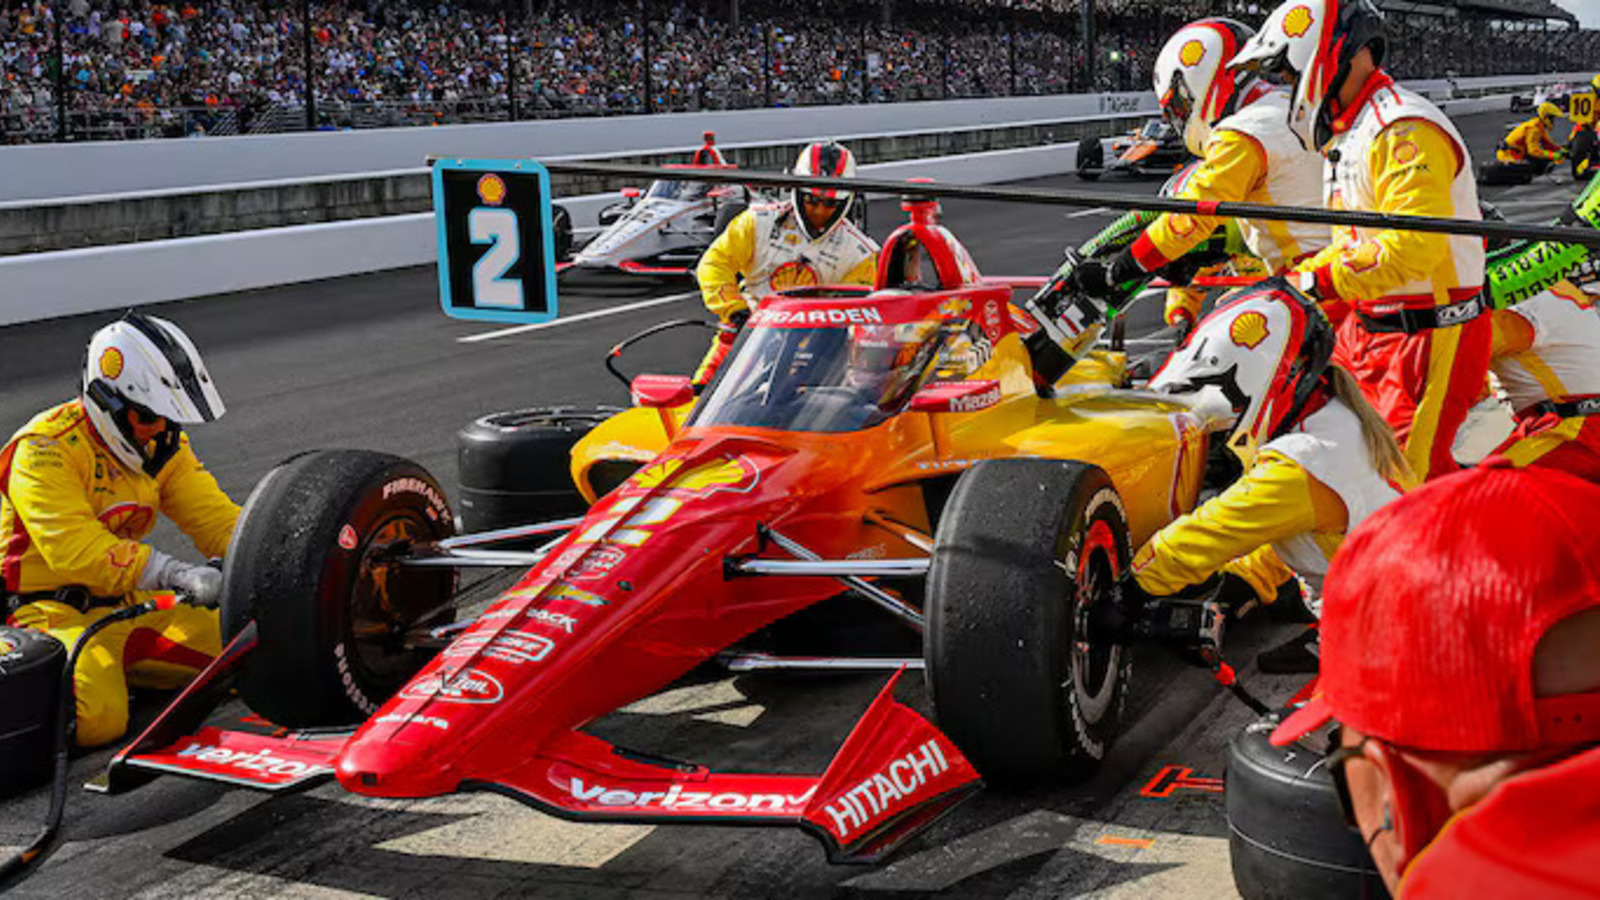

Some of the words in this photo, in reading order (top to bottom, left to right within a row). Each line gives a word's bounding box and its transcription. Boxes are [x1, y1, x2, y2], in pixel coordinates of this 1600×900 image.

[1574, 97, 1591, 115] 10
[467, 206, 525, 310] 2
[569, 777, 791, 810] verizon
[825, 739, 951, 838] HITACHI
